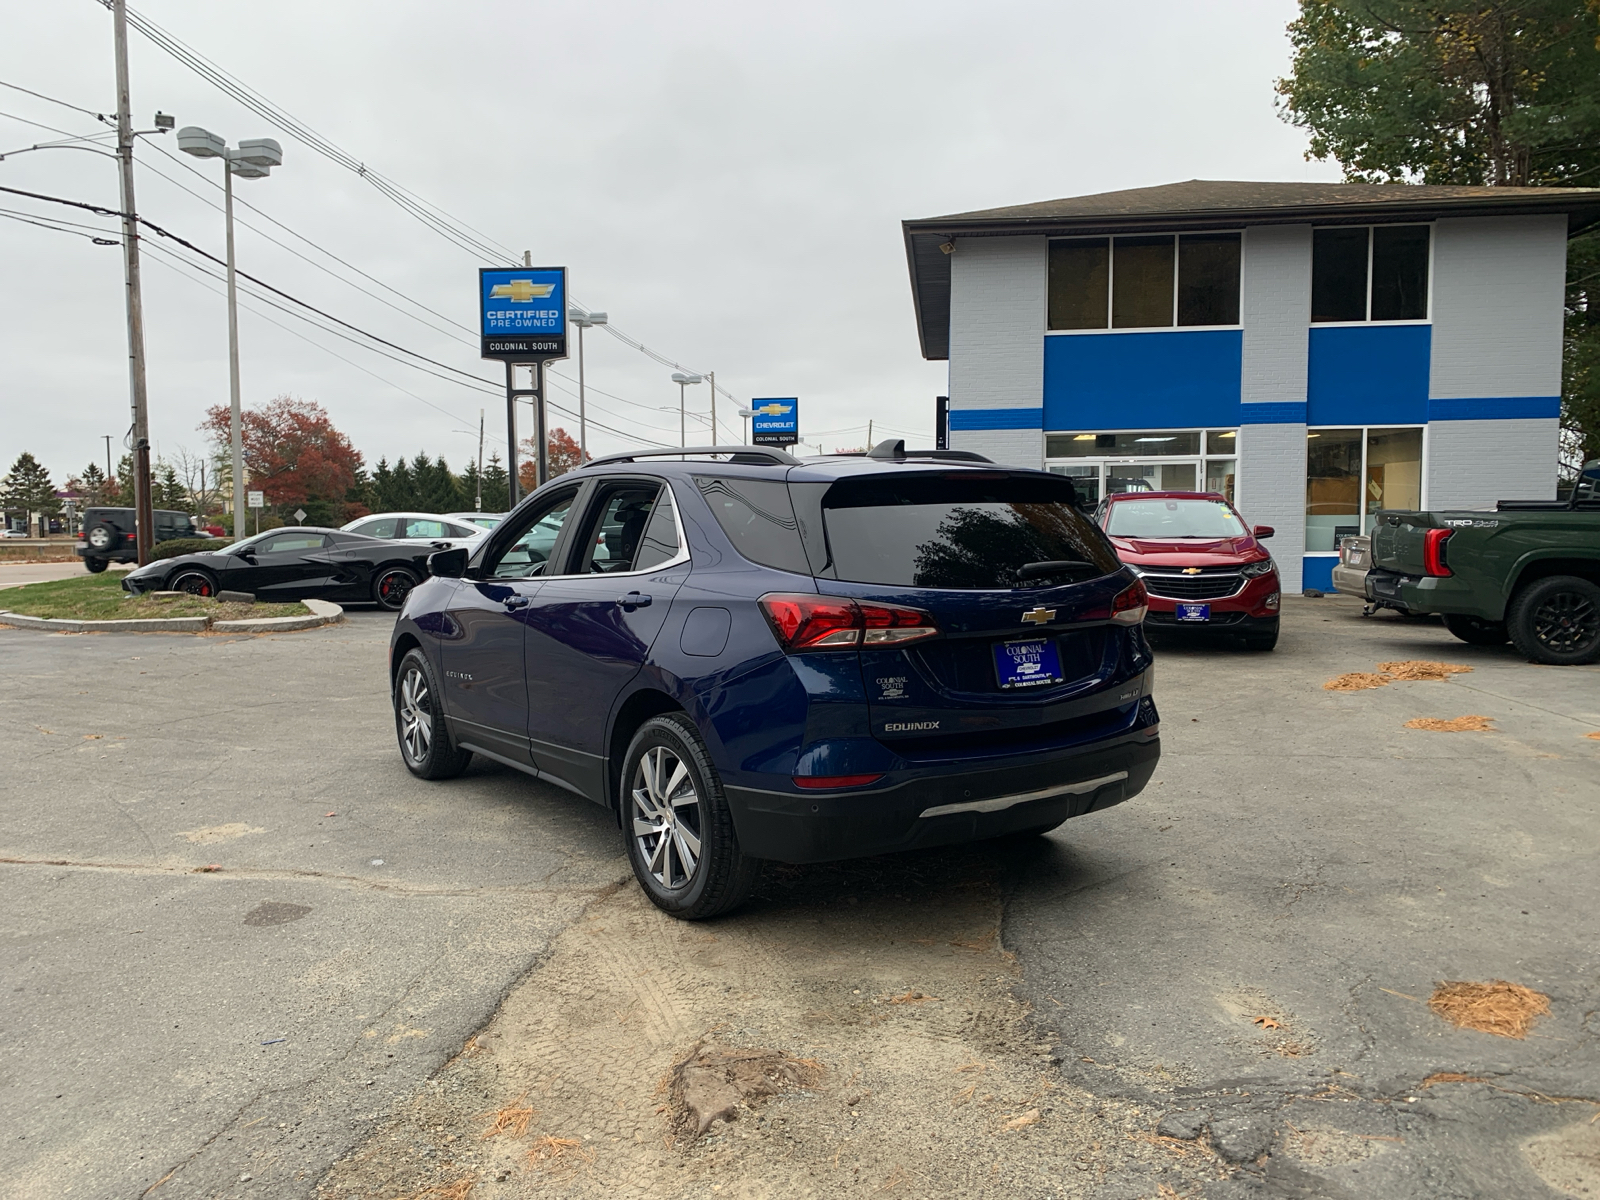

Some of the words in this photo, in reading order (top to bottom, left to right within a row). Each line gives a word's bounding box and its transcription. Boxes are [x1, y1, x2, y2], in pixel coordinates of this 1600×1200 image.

[487, 310, 559, 319] CERTIFIED
[490, 319, 556, 327] PRE-OWNED
[489, 342, 528, 351] COLONIAL
[532, 342, 558, 350] SOUTH
[1006, 644, 1045, 656] COLONIAL
[1013, 654, 1041, 664] SOUTH
[876, 677, 908, 685] COLONIAL
[881, 682, 904, 690] SOUTH
[884, 721, 940, 732] EQUINOX
